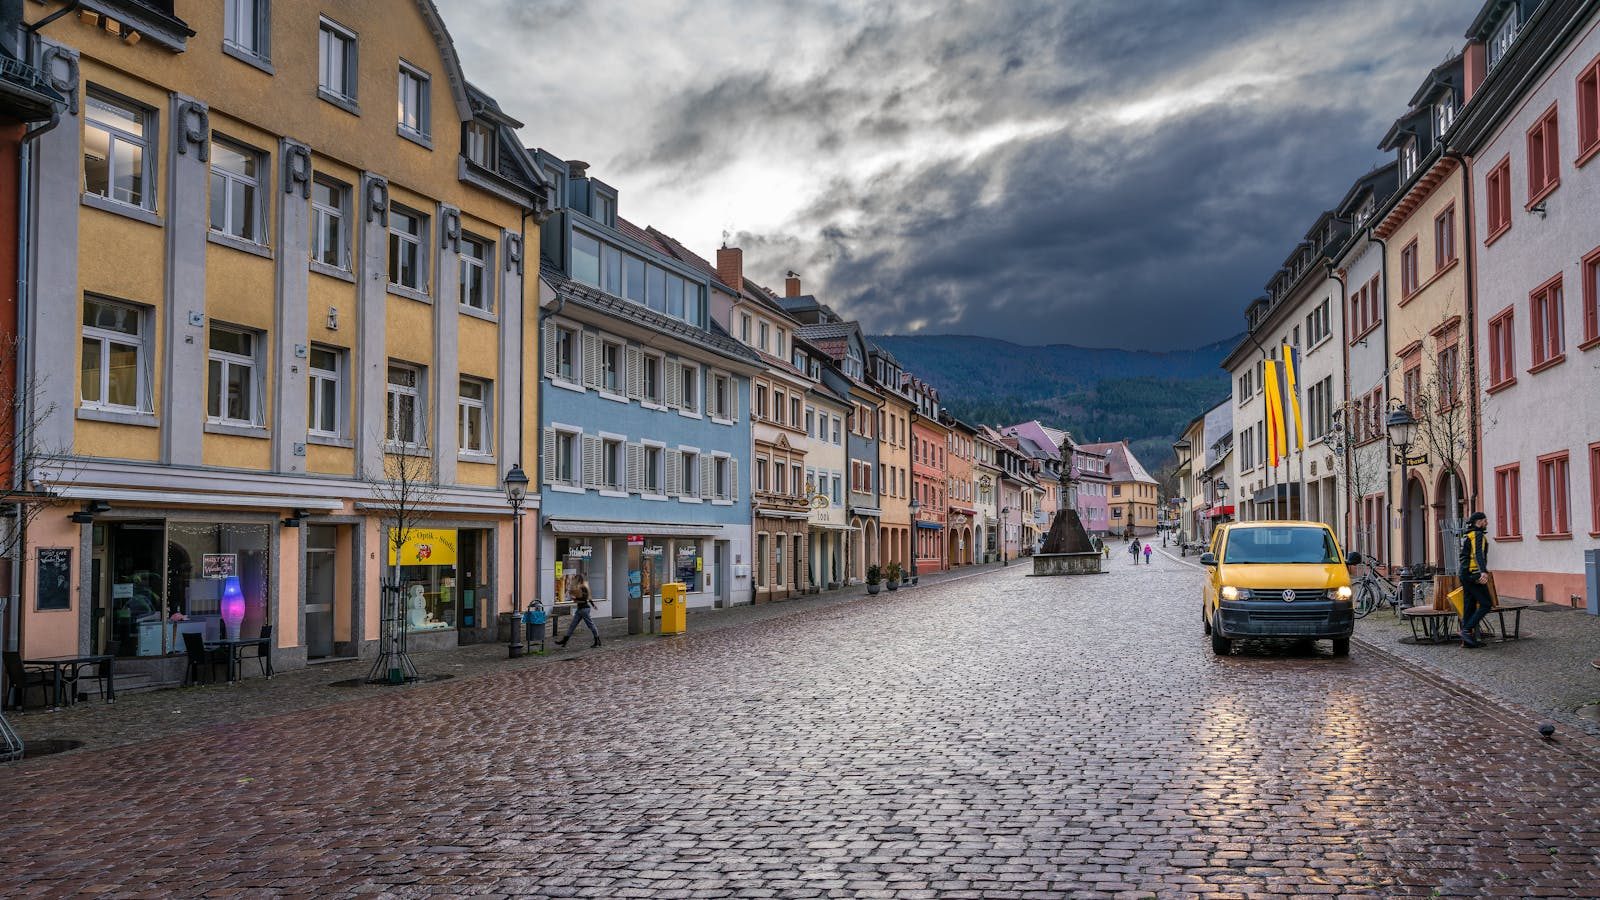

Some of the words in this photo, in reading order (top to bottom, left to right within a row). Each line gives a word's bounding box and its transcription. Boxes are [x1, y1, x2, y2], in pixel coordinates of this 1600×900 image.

[417, 532, 433, 541] Optik
[440, 536, 455, 553] Studio
[370, 552, 375, 560] 6
[1283, 590, 1296, 602] VW
